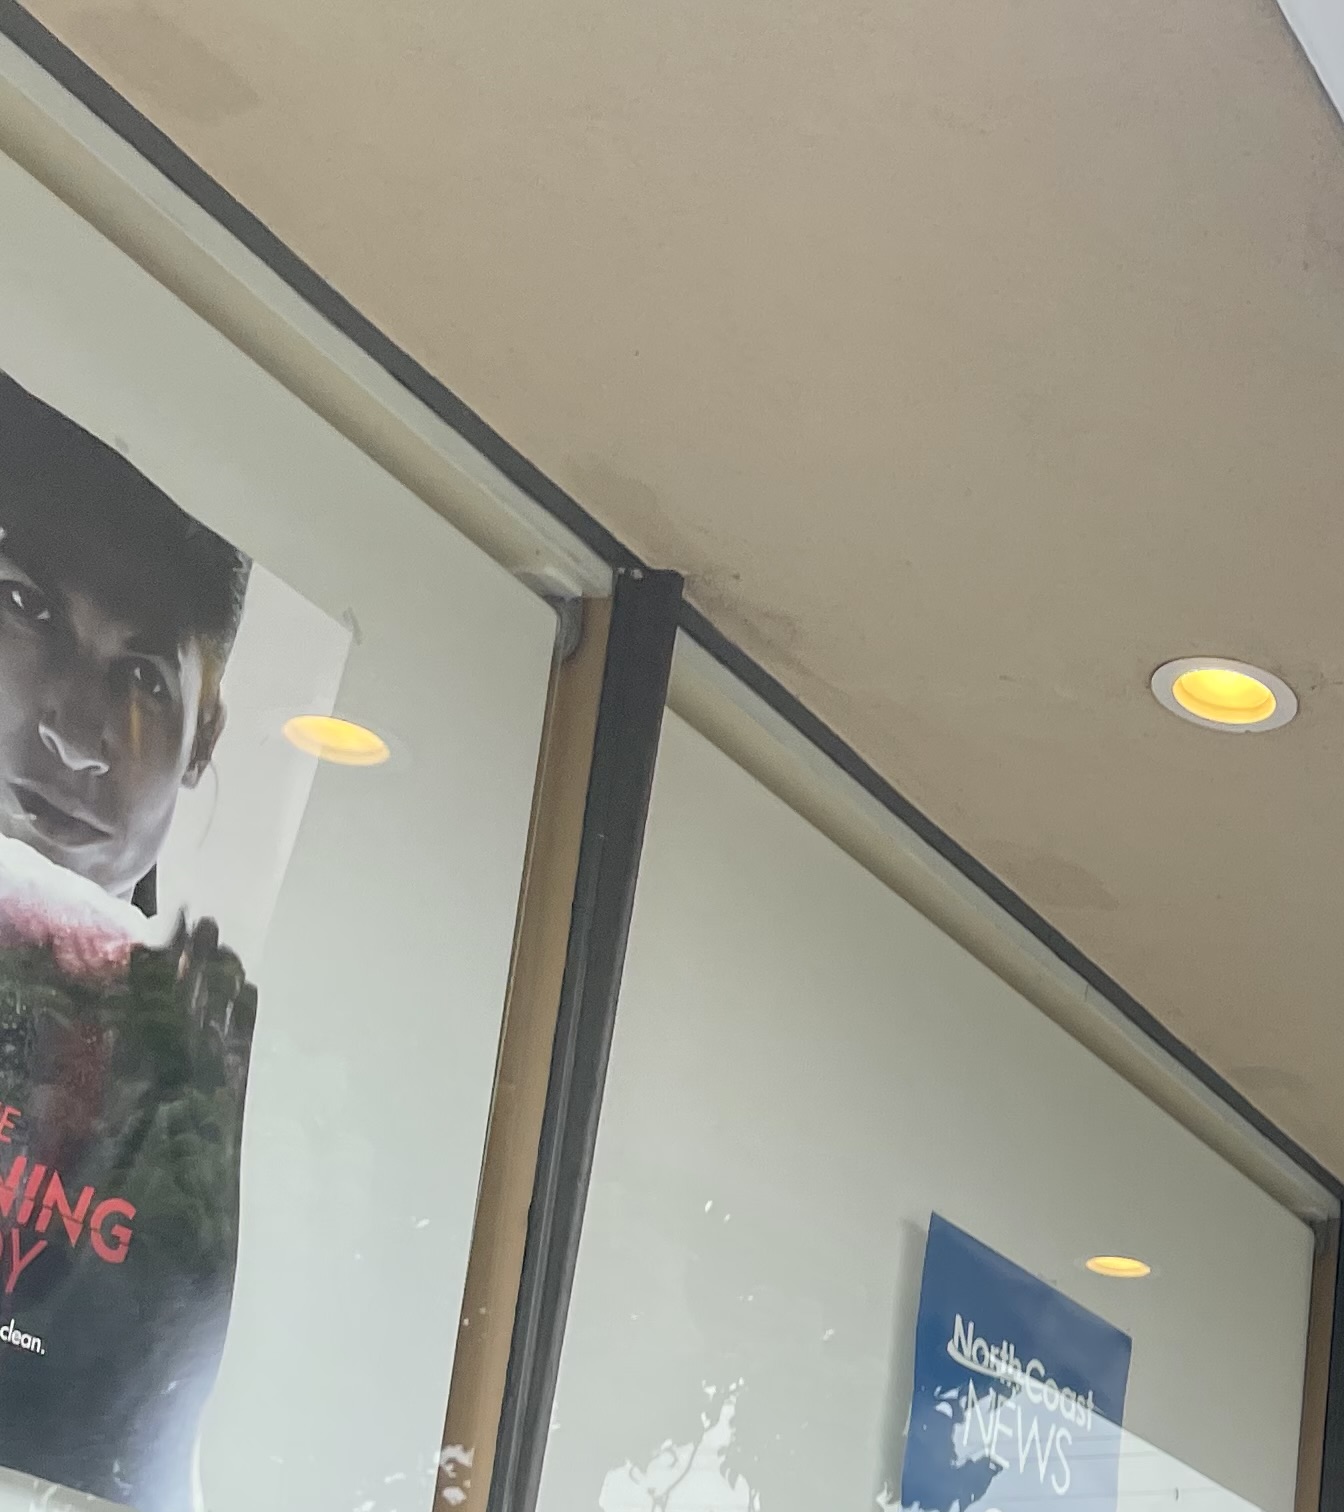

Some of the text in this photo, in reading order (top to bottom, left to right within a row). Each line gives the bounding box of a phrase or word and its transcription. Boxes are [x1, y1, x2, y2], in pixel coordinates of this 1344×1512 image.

[953, 1313, 1095, 1432] North Coast
[962, 1377, 1073, 1496] NEWS
